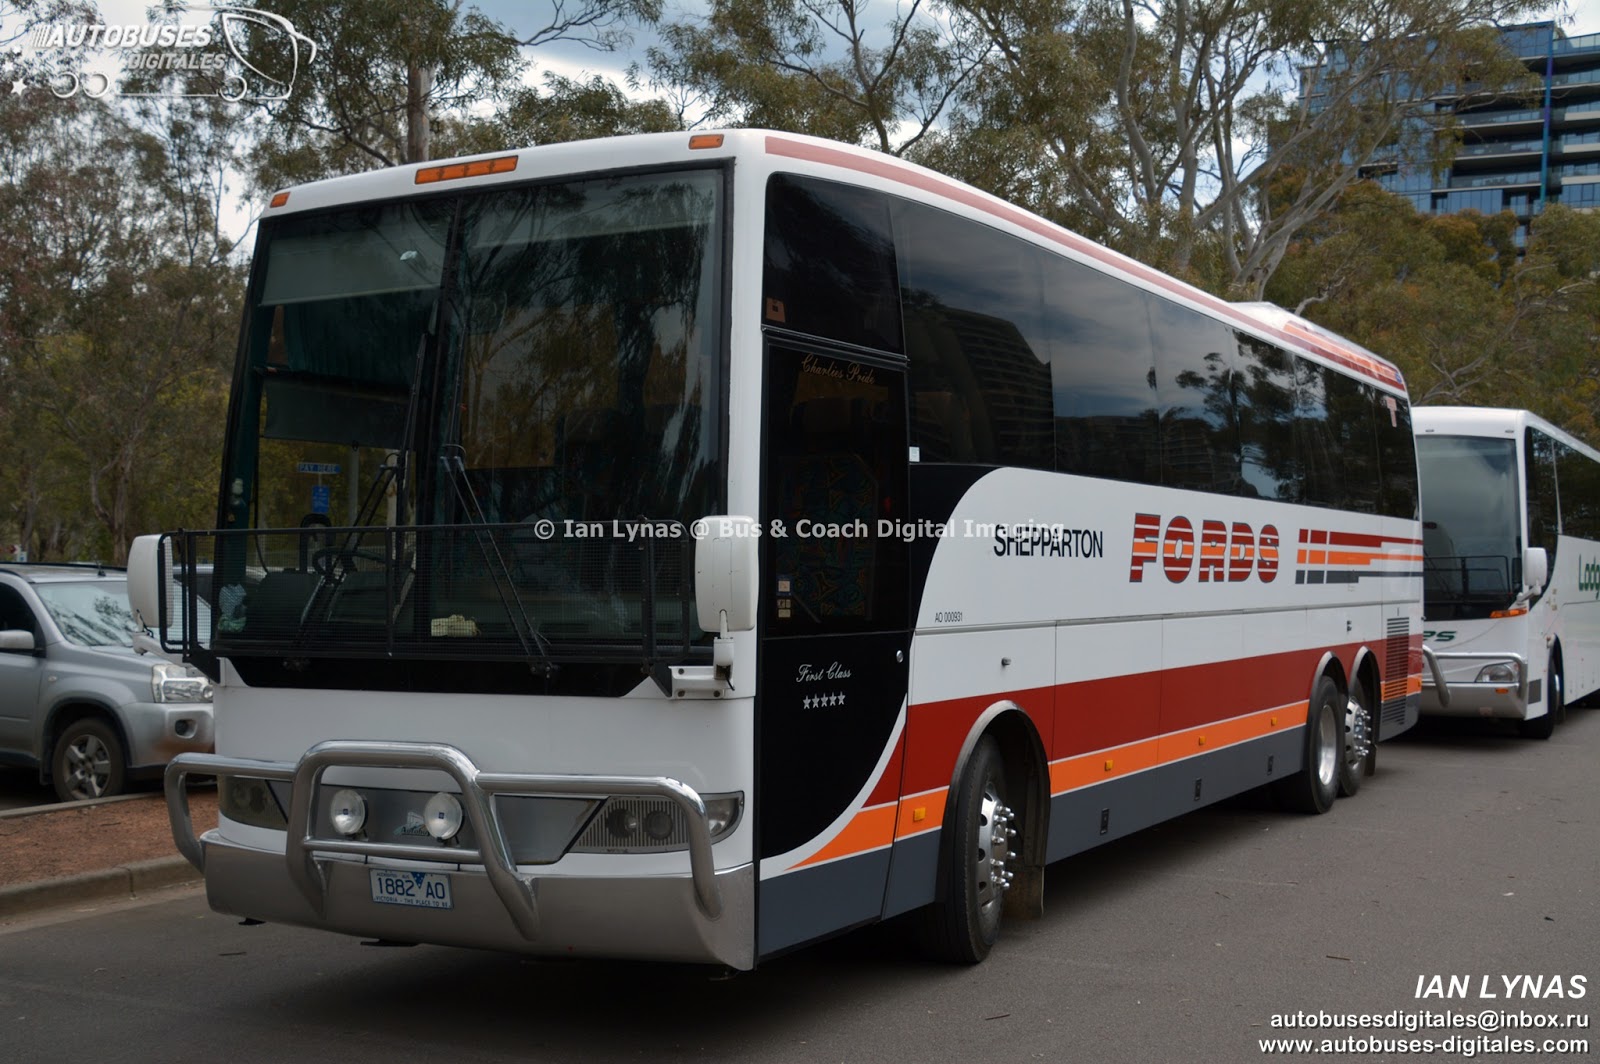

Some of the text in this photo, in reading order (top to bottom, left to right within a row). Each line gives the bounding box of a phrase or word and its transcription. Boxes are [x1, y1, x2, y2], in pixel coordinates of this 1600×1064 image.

[846, 362, 875, 384] Pride
[993, 524, 1103, 558] SHEPPARTON
[1129, 512, 1280, 584] FORDS
[944, 611, 963, 623] 000931
[796, 661, 852, 683] First Class
[376, 895, 398, 903] VICTORIA
[378, 877, 446, 900] 1882 AO
